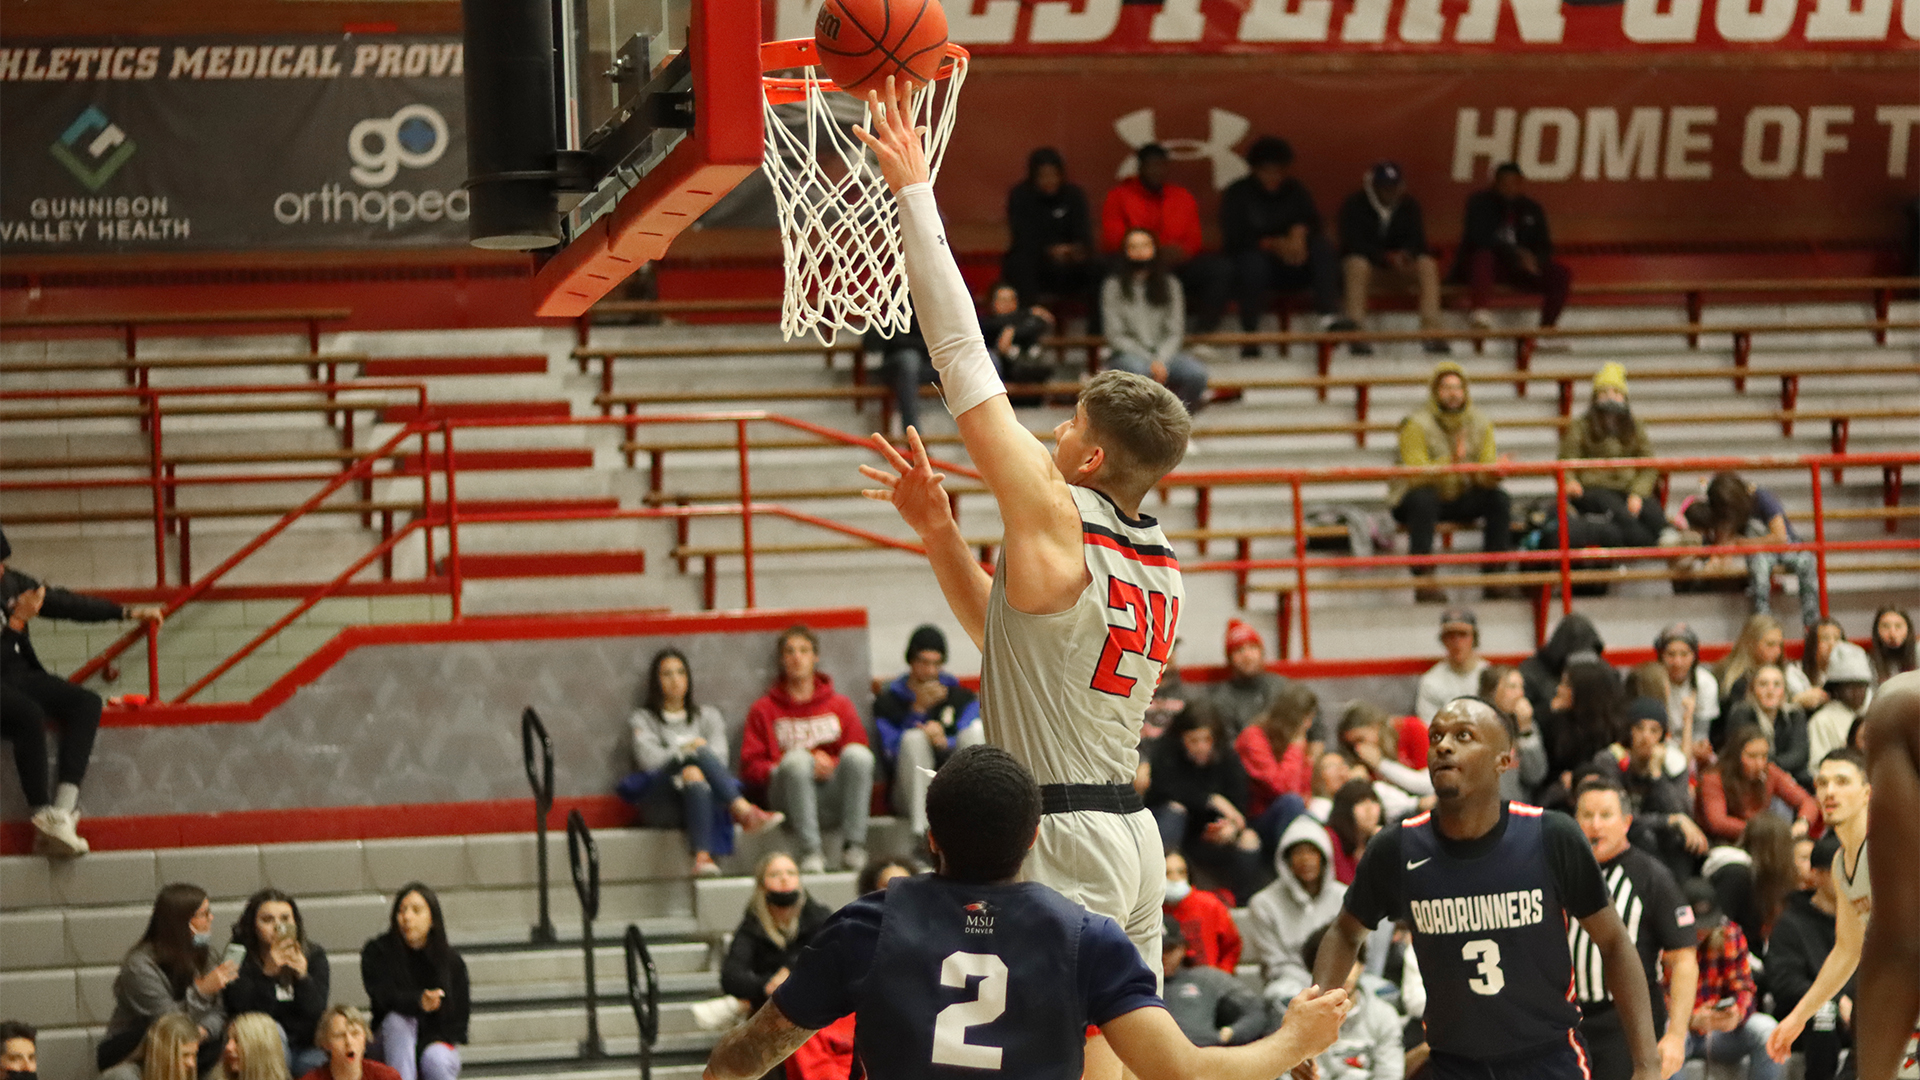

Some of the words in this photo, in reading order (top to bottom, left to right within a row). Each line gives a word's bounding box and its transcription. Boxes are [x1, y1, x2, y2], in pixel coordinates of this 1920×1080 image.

[168, 45, 342, 80] MEDICAL
[1451, 106, 1718, 182] HOME
[1740, 105, 1854, 180] OF
[30, 196, 168, 219] GUNNISON
[0, 219, 87, 242] VALLEY
[97, 217, 191, 241] HEALTH
[1089, 573, 1180, 704] 24
[964, 926, 994, 934] DENVER
[966, 915, 994, 927] MSU
[1410, 888, 1543, 935] ROADRUNNERS
[1461, 938, 1505, 996] 3
[931, 950, 1009, 1070] 2
